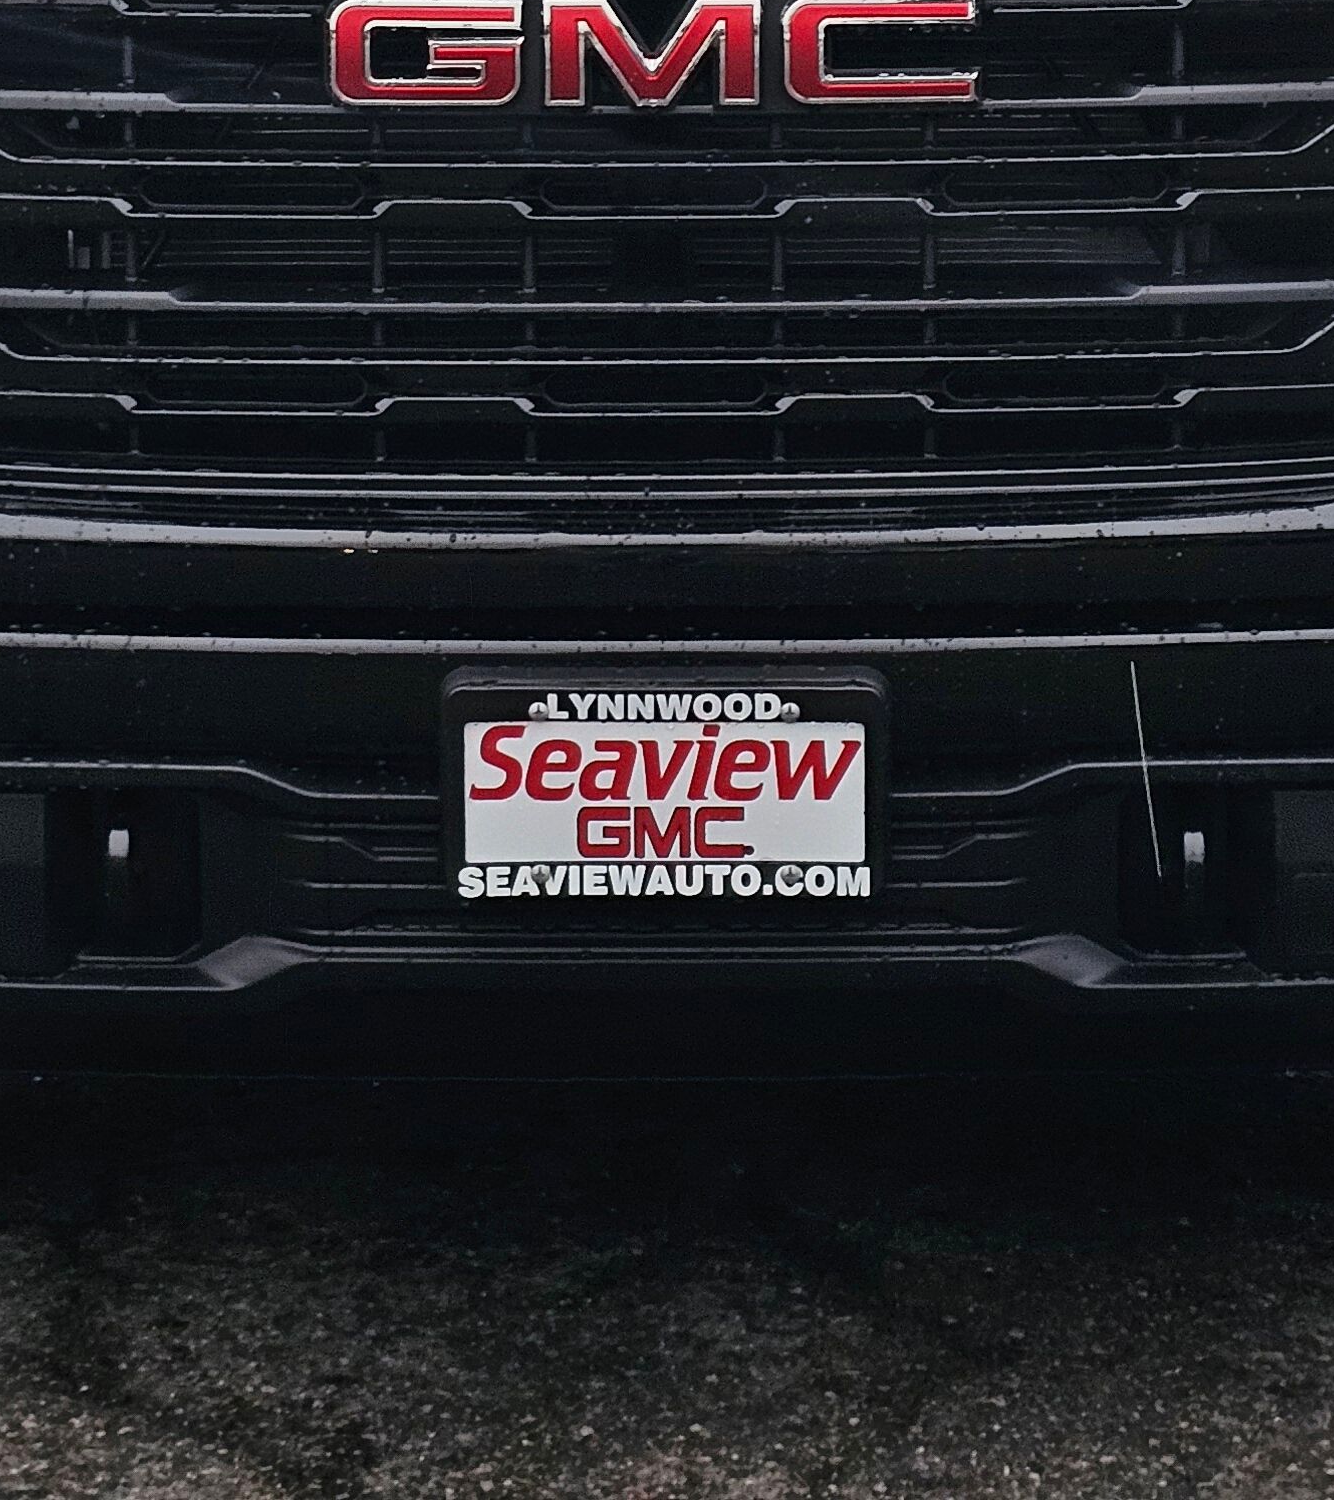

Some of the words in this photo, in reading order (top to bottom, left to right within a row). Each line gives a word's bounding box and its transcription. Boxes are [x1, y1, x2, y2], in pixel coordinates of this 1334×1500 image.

[546, 693, 782, 721] LYNNWOOD
[468, 724, 862, 801] Seaview
[576, 806, 745, 859] GMC
[458, 864, 871, 898] SEAVIEWAUTO.COM
